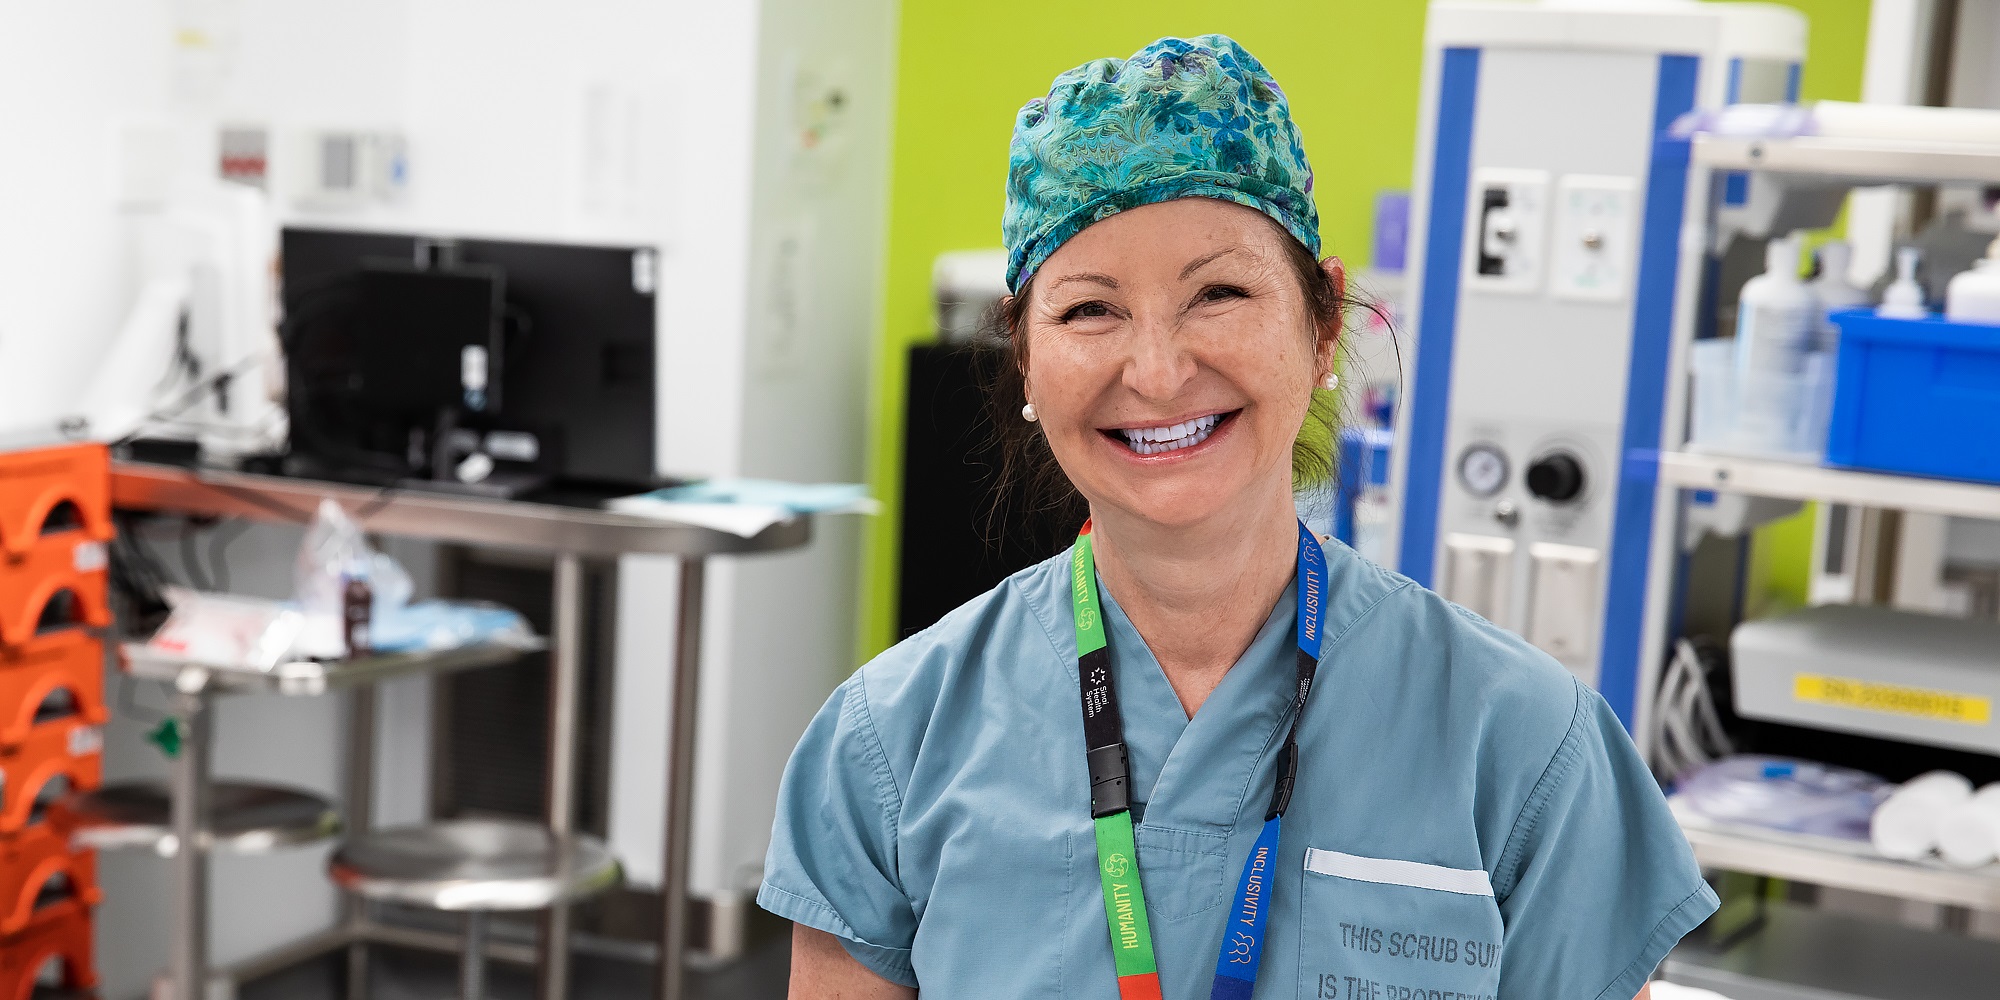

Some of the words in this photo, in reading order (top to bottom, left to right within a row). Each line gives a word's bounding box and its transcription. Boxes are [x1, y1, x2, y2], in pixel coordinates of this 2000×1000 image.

[1075, 545, 1089, 604] HUMANITY
[1305, 568, 1319, 641] INCLUSIVITY
[1085, 690, 1095, 718] System
[1093, 687, 1102, 713] Health
[1100, 685, 1110, 705] Sinai
[1240, 847, 1269, 927] INCLUSIVITY
[1112, 883, 1139, 949] HUMANITY
[1339, 922, 1383, 954] THIS
[1387, 931, 1458, 964] SCRUB
[1317, 973, 1338, 1000] IS
